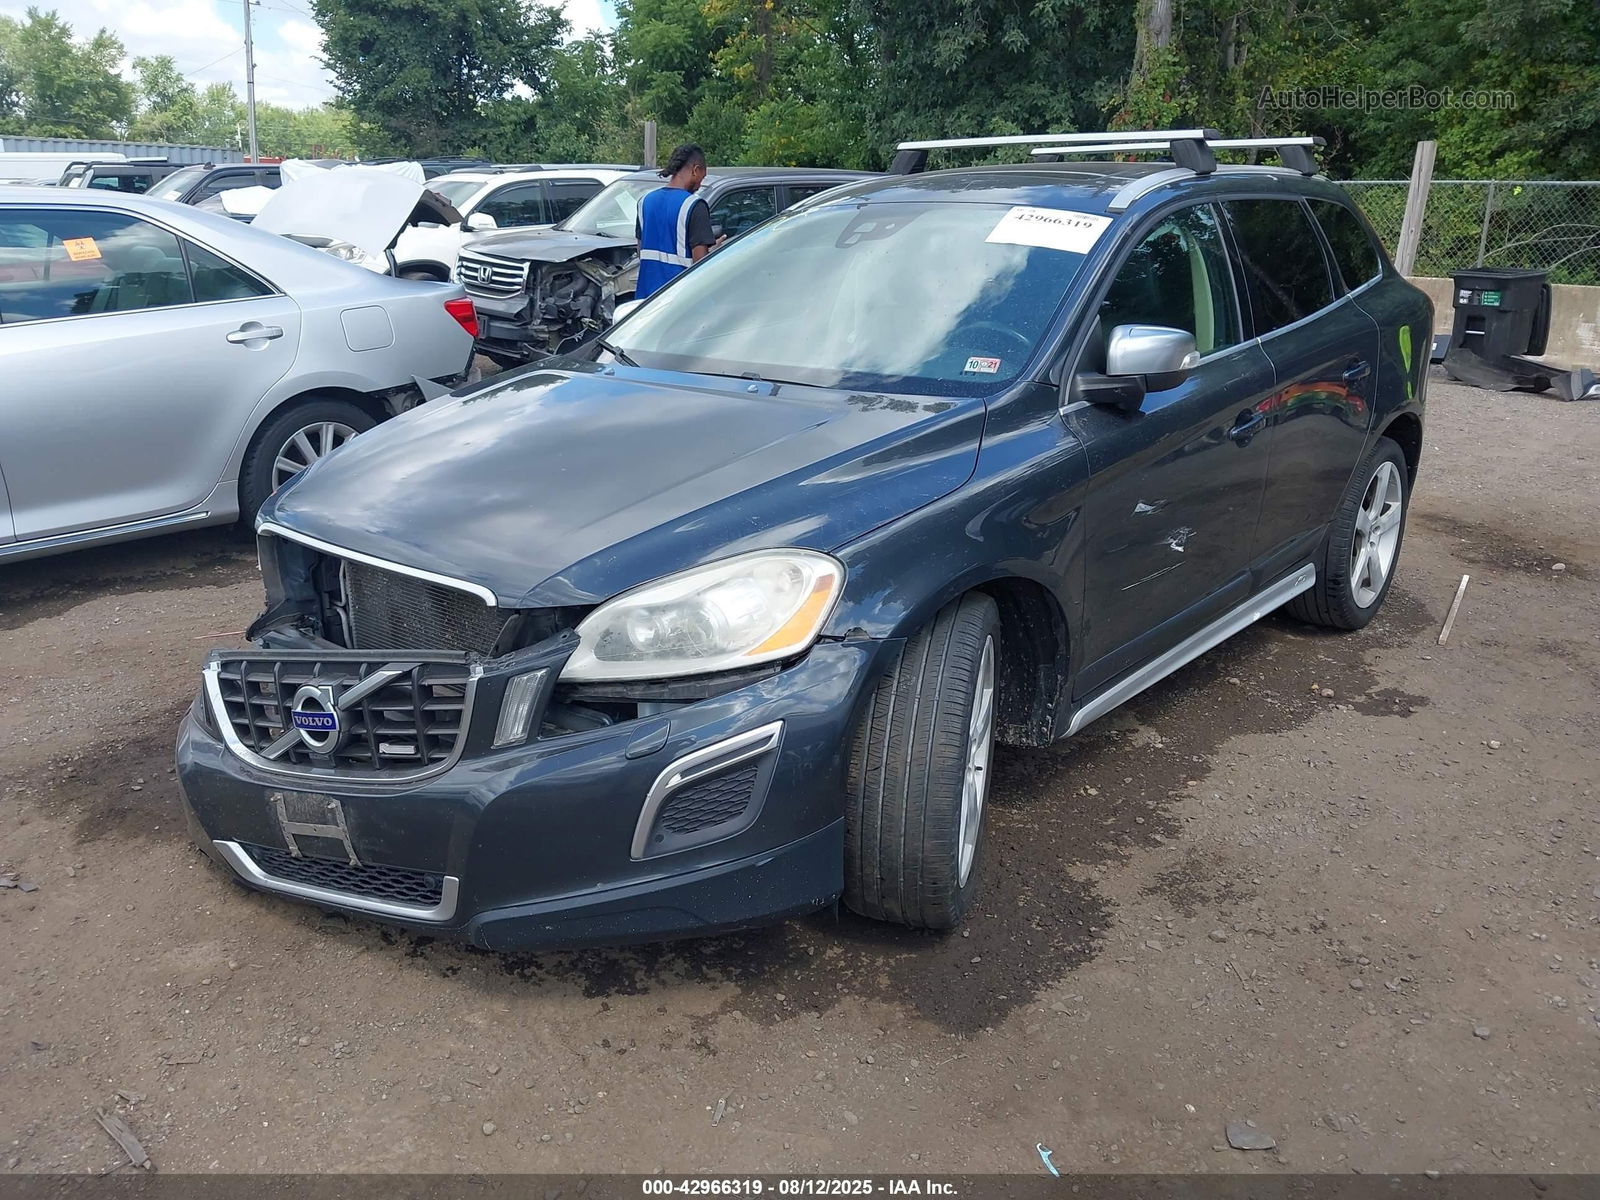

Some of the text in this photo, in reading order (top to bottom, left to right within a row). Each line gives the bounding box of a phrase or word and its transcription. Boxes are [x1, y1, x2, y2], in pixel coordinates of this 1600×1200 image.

[1015, 214, 1093, 228] 42966319
[969, 360, 998, 369] 10 21
[294, 715, 333, 727] VOLVO
